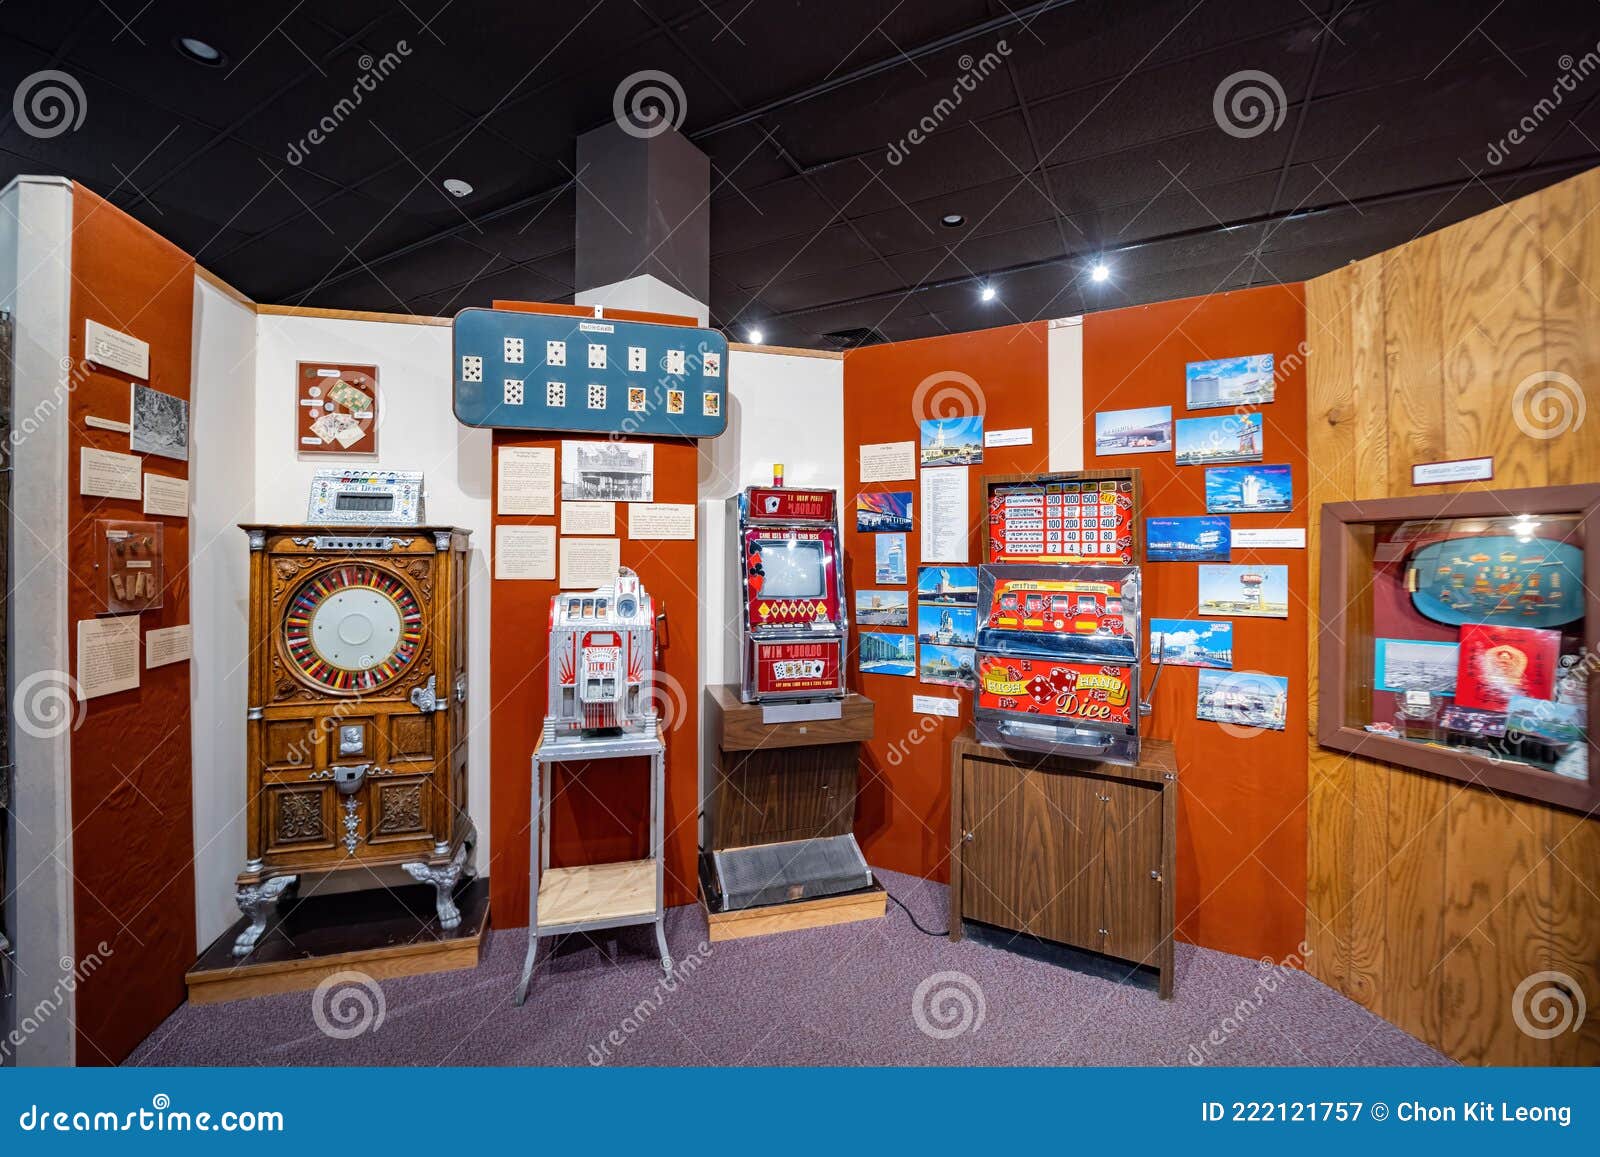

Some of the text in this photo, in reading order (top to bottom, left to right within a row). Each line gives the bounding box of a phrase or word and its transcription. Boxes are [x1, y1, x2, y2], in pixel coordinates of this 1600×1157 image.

[1048, 495, 1060, 504] 500
[1065, 495, 1078, 504] 1000
[1083, 494, 1097, 503] 1500
[1048, 520, 1060, 528] 100
[1065, 520, 1078, 528] 200
[1083, 519, 1096, 528] 300
[1101, 519, 1115, 527] 400
[1050, 532, 1059, 540] 20
[1067, 532, 1076, 540] 40
[1085, 532, 1095, 540] 60
[1103, 532, 1113, 540] 80
[1052, 545, 1057, 553] 2
[1069, 545, 1075, 553] 4
[1087, 545, 1092, 553] 6
[1106, 545, 1111, 553] 8
[763, 646, 782, 659] WIN
[987, 675, 1122, 694] HIGH HAND
[1055, 693, 1111, 718] Dice
